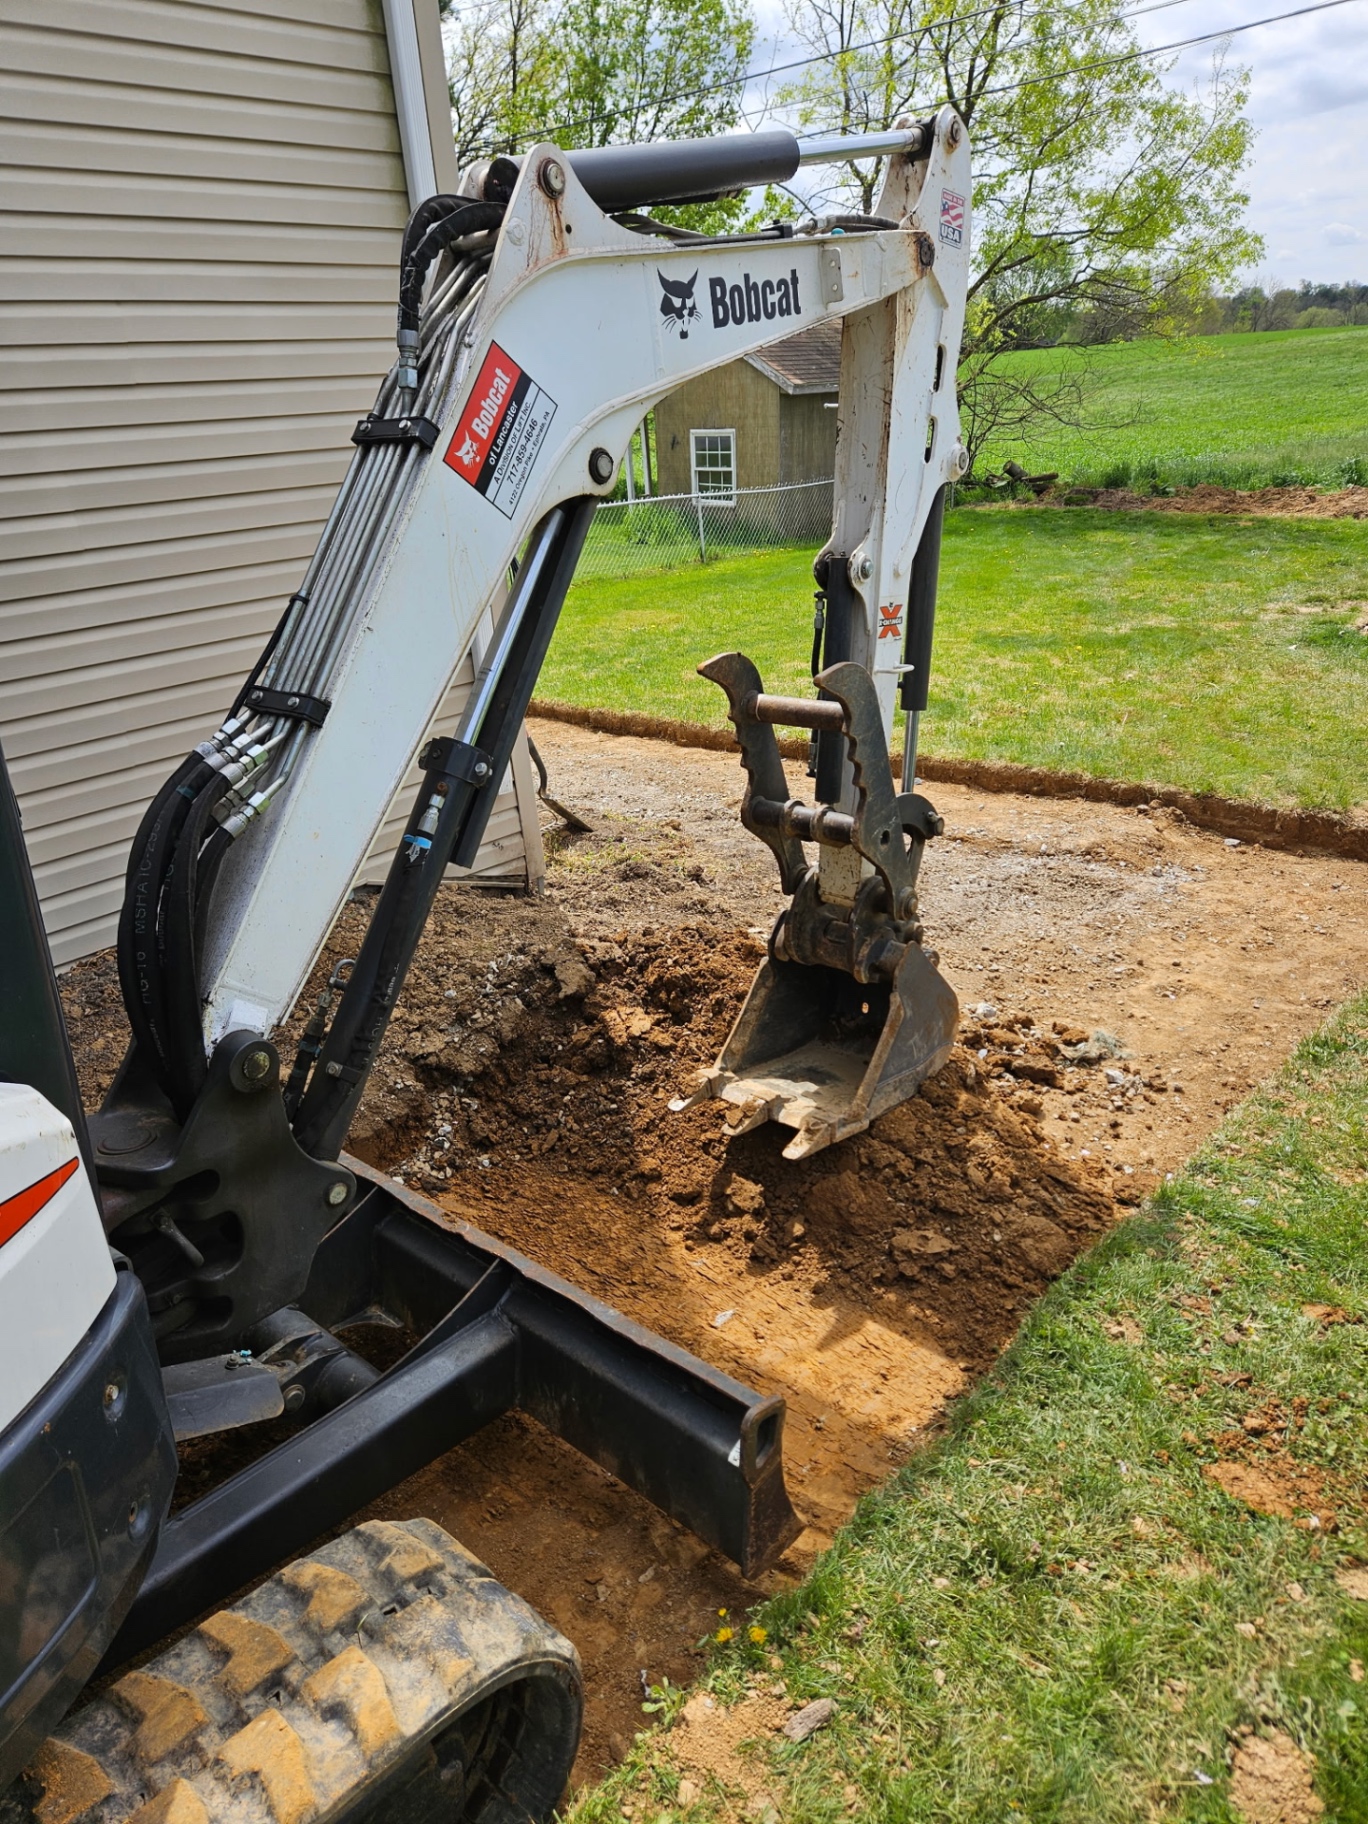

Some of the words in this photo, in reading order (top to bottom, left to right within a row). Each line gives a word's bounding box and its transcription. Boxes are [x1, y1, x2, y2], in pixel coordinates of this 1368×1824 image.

[941, 225, 960, 242] USA
[708, 268, 802, 329] Bobcat
[471, 367, 511, 440] Bobcat
[492, 400, 518, 453] Lancaster
[488, 451, 498, 465] of
[493, 476, 501, 484] A
[510, 431, 518, 444] OF
[506, 418, 538, 484] 717-859-4646
[515, 466, 528, 489] Oregon
[524, 452, 534, 466] Pike
[543, 411, 551, 422] PA
[134, 881, 149, 934] MSHA
